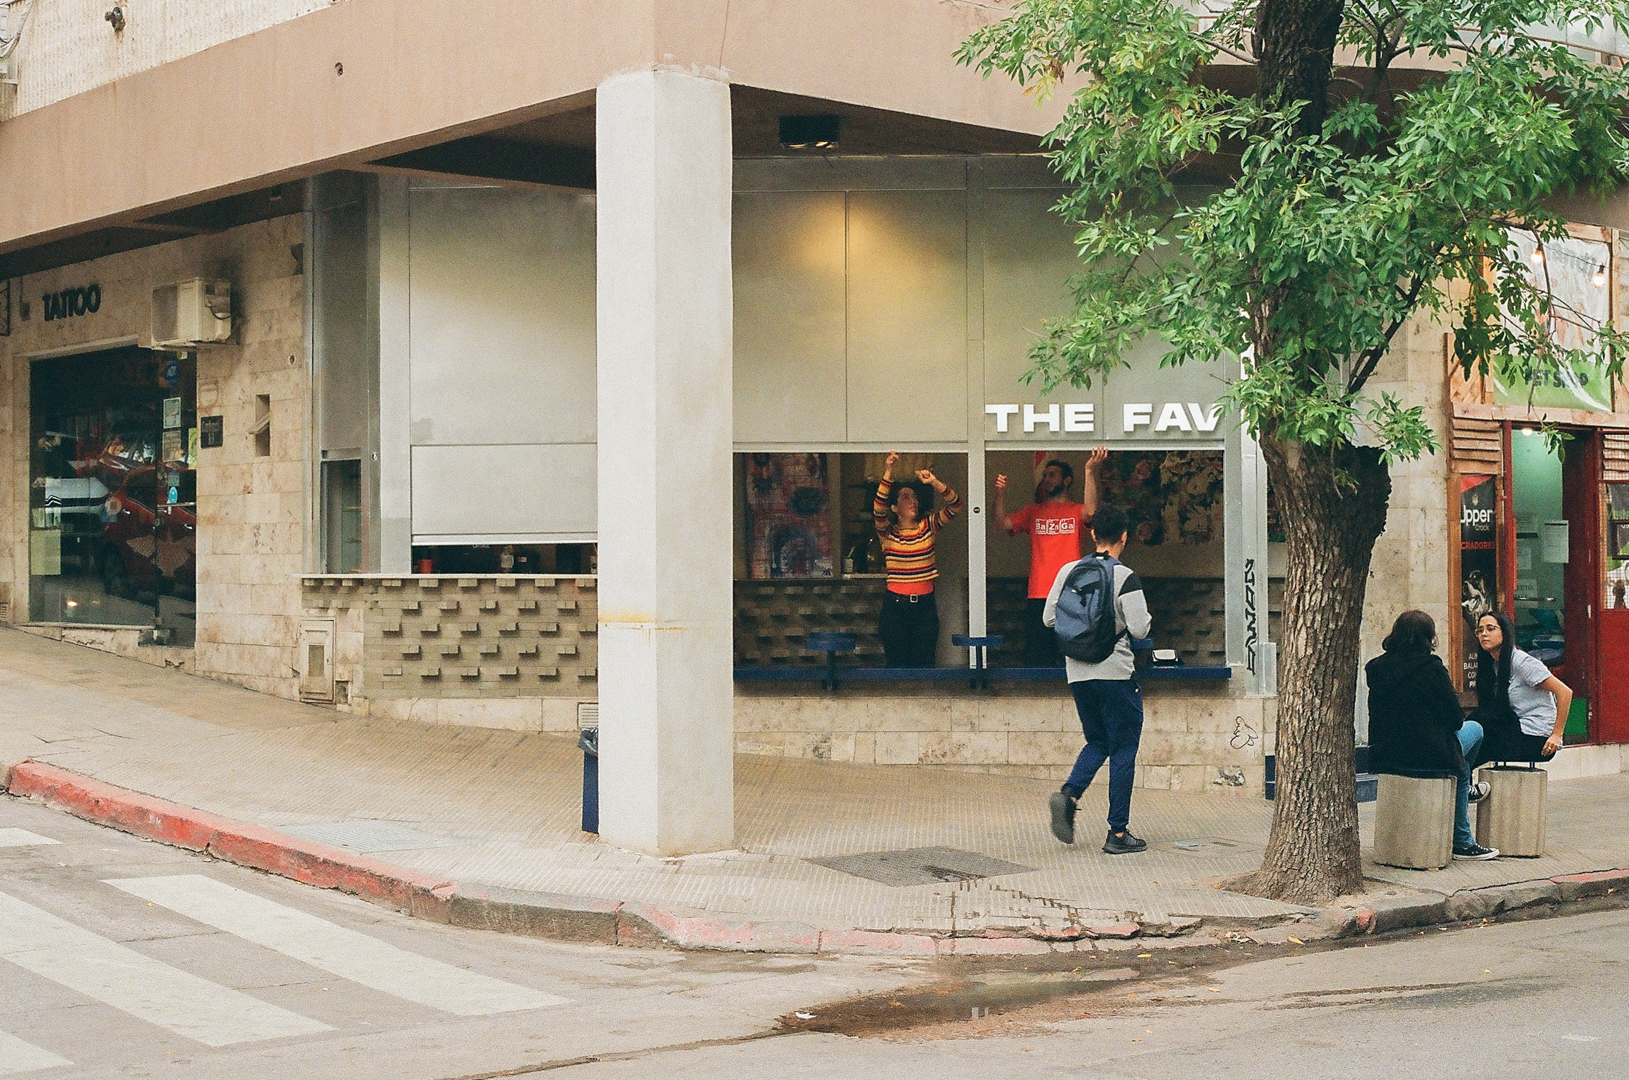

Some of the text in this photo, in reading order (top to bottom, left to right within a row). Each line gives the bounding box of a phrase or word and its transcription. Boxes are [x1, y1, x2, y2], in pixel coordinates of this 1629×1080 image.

[42, 284, 101, 321] TATTOO
[985, 402, 1224, 433] THE FAV
